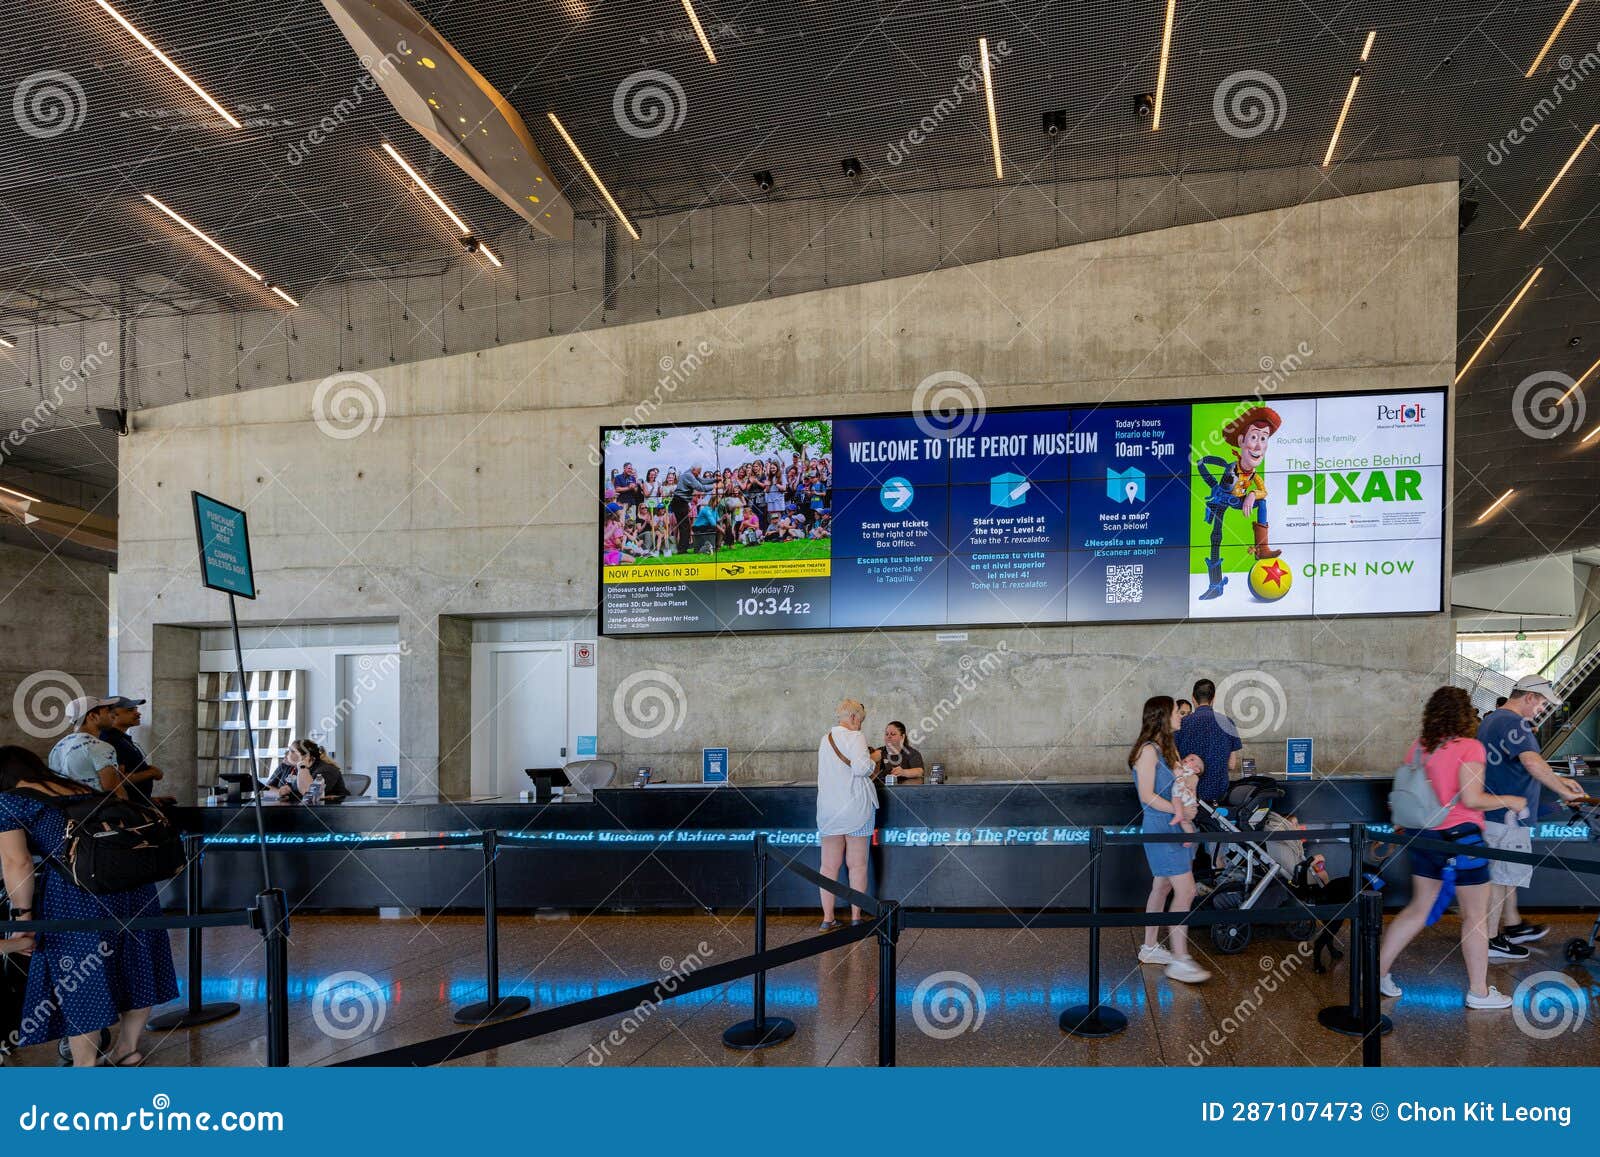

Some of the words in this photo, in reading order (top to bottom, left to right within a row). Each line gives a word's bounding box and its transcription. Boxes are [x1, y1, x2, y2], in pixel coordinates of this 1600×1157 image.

[1115, 419, 1140, 428] Today's
[1142, 419, 1161, 427] hours
[1115, 430, 1140, 439] Horario
[1142, 430, 1151, 438] de
[1152, 429, 1165, 439] hoy
[1277, 437, 1302, 445] Round
[1304, 437, 1315, 445] up
[849, 440, 918, 463] WELCOME
[924, 438, 941, 459] TO
[947, 437, 975, 458] THE
[980, 435, 1028, 458] PEROT
[1033, 432, 1098, 456] MUSEUM
[1115, 442, 1143, 458] 10am
[1151, 441, 1174, 459] 5pm
[1286, 458, 1311, 470] The
[1316, 457, 1368, 469] Science
[1373, 453, 1421, 466] Behind
[1287, 469, 1423, 506] PIXAR
[1129, 512, 1150, 520] map?
[887, 530, 904, 539] right
[1138, 537, 1164, 546] mapa?
[1013, 561, 1045, 570] superior
[1302, 563, 1357, 578] OPEN
[1365, 560, 1415, 575] NOW
[632, 569, 670, 578] PLAYING
[685, 568, 698, 576] 3D!
[752, 586, 780, 595] Monday
[782, 585, 795, 593] 7/3
[736, 597, 792, 615] 10:34
[794, 603, 810, 614] 22
[760, 830, 820, 844] cience!
[884, 828, 950, 842] Welcome
[956, 828, 972, 842] to
[976, 828, 1003, 842] The
[1007, 828, 1048, 842] Perot
